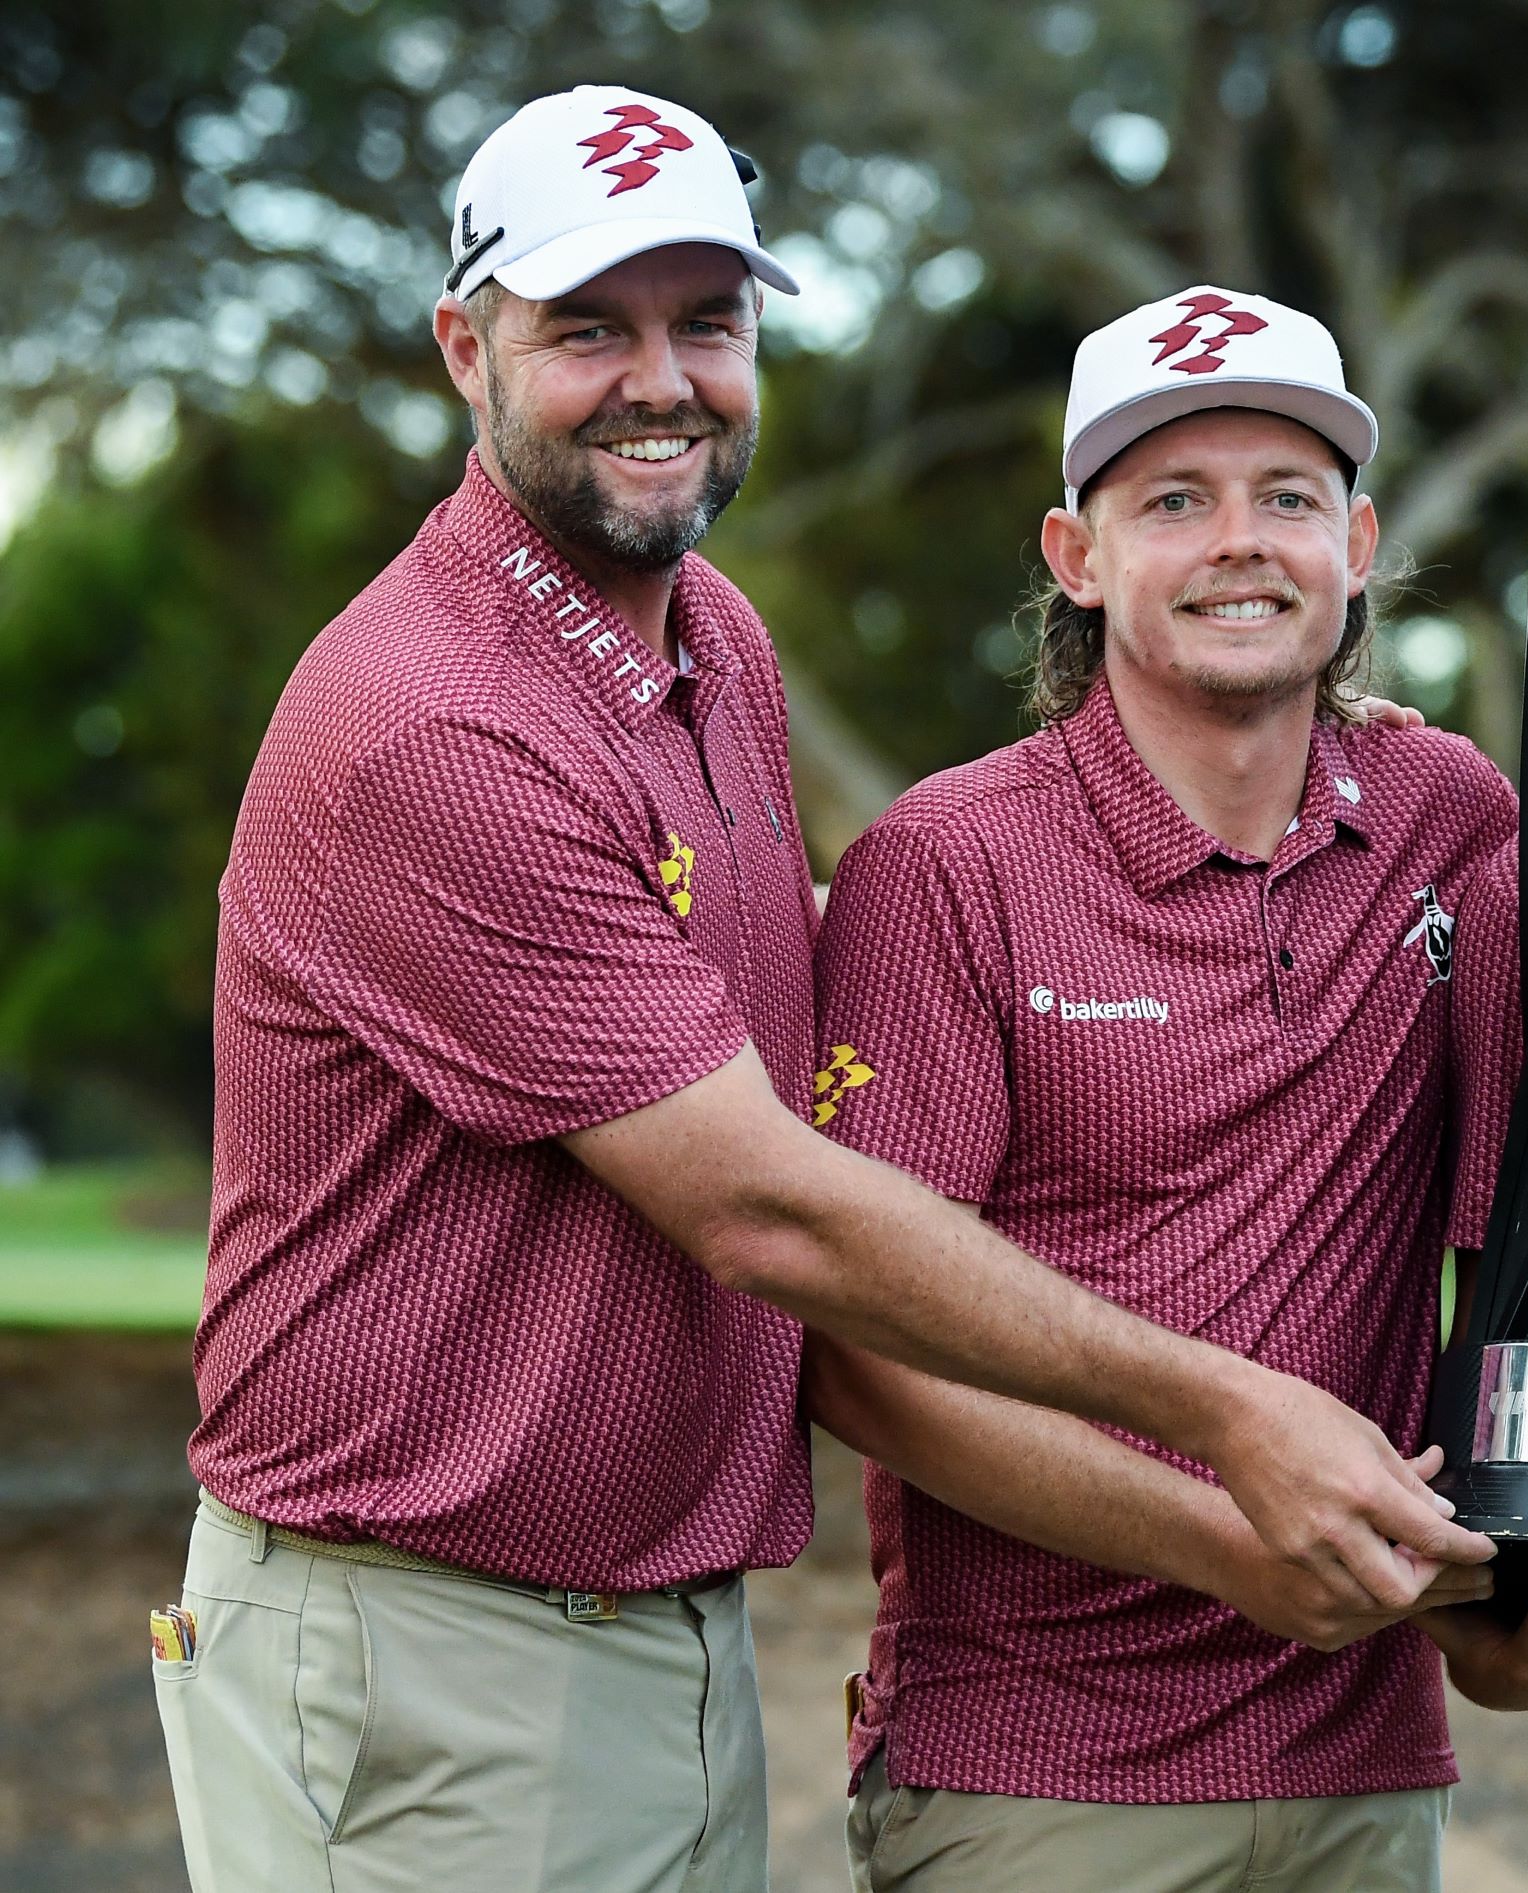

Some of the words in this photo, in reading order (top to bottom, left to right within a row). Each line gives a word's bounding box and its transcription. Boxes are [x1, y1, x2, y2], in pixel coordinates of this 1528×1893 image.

[500, 546, 660, 704] NETJETS
[1060, 997, 1168, 1024] bakertilly
[570, 1601, 599, 1612] PLAYER
